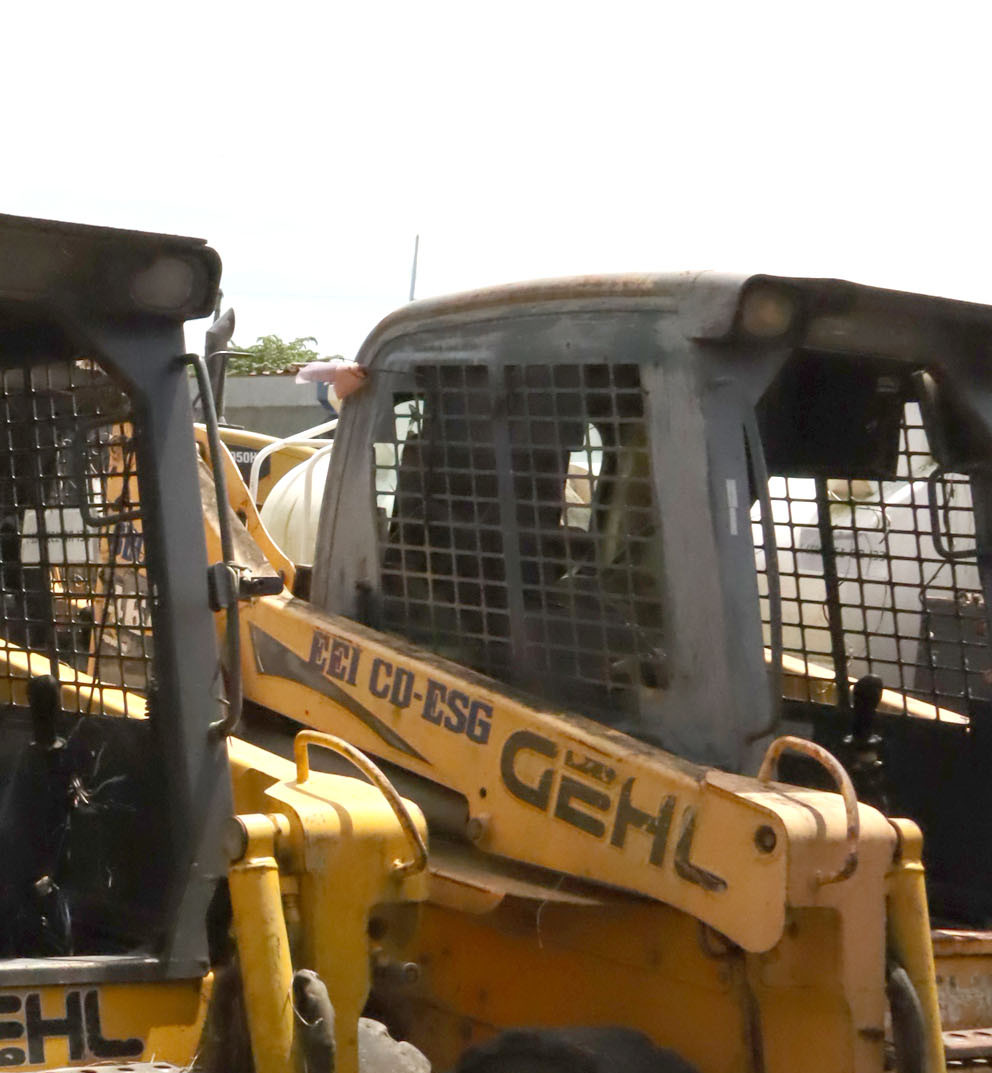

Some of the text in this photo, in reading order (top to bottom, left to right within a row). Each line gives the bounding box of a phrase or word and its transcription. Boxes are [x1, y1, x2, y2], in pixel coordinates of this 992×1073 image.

[308, 629, 494, 745] EEI CD-ESG
[500, 728, 729, 893] GEHL
